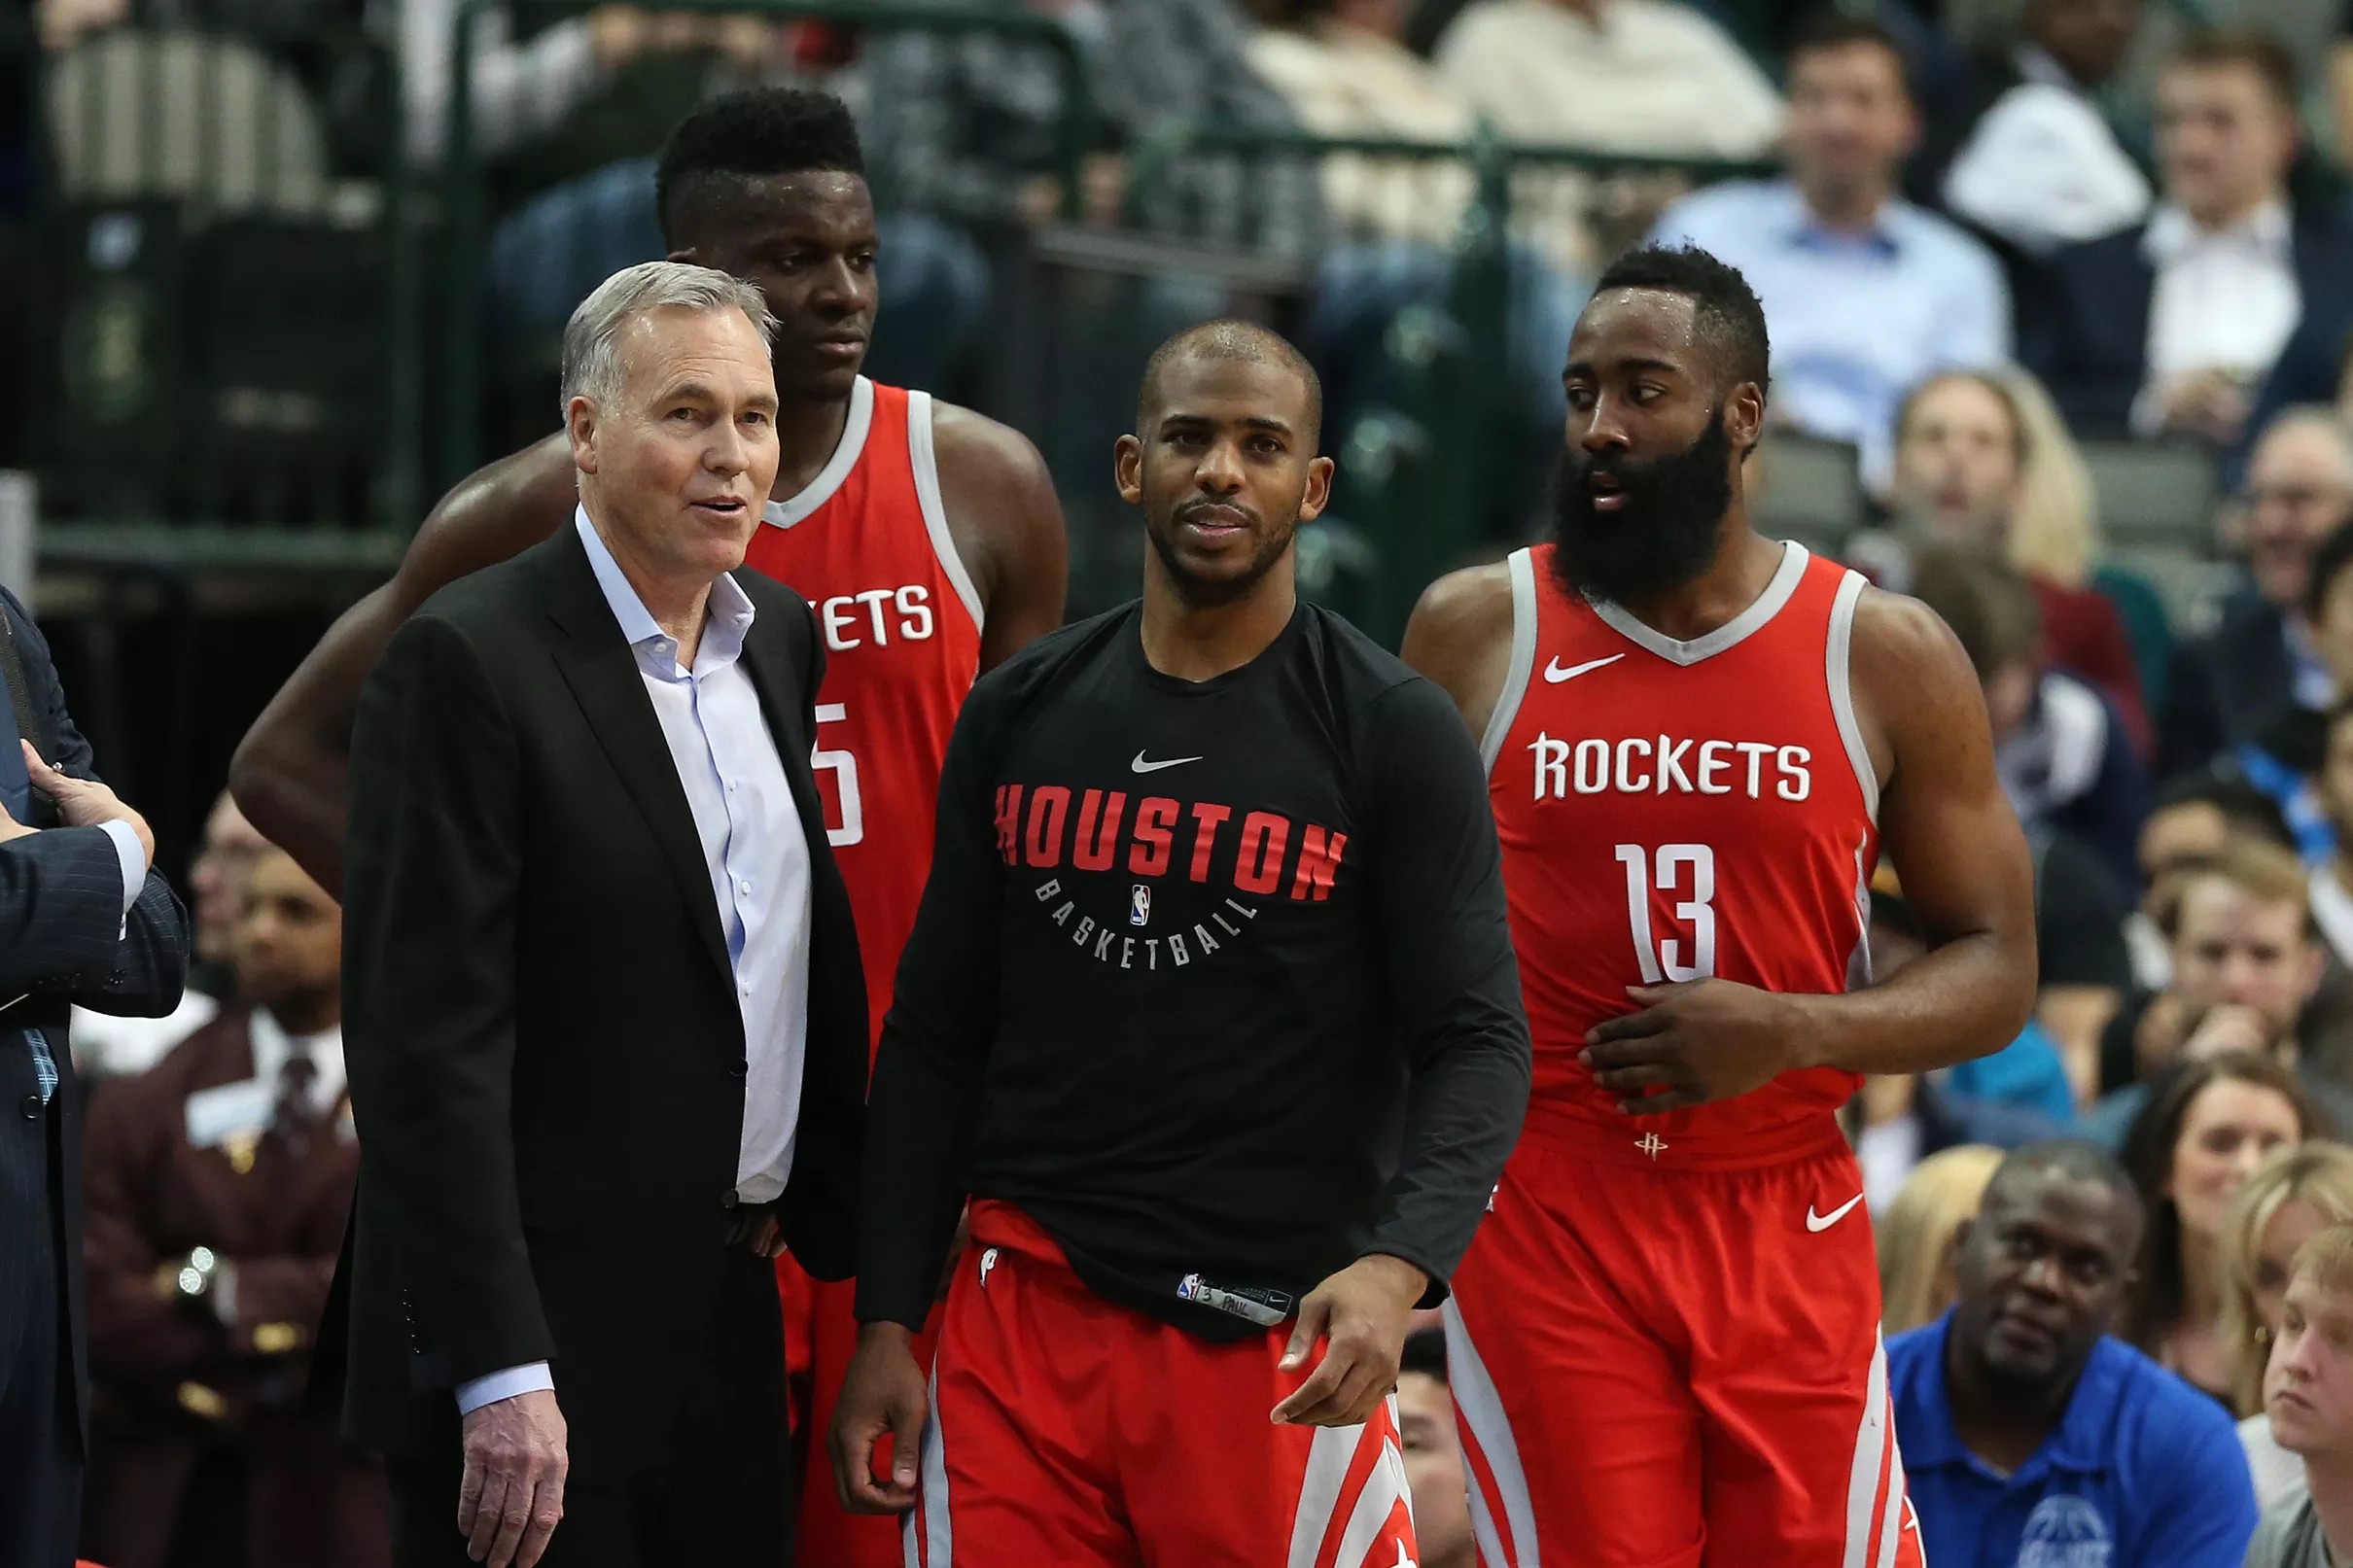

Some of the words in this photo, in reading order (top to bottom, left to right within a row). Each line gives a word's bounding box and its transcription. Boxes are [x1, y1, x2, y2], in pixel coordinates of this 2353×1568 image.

[807, 584, 934, 650] ETS
[1527, 731, 1810, 802] ROCKETS
[994, 784, 1348, 902] HOUSTON
[1036, 878, 1257, 970] BASKETBALL
[1614, 843, 1715, 984] 13
[1203, 1288, 1212, 1302] 3
[1223, 1295, 1249, 1316] PAUL
